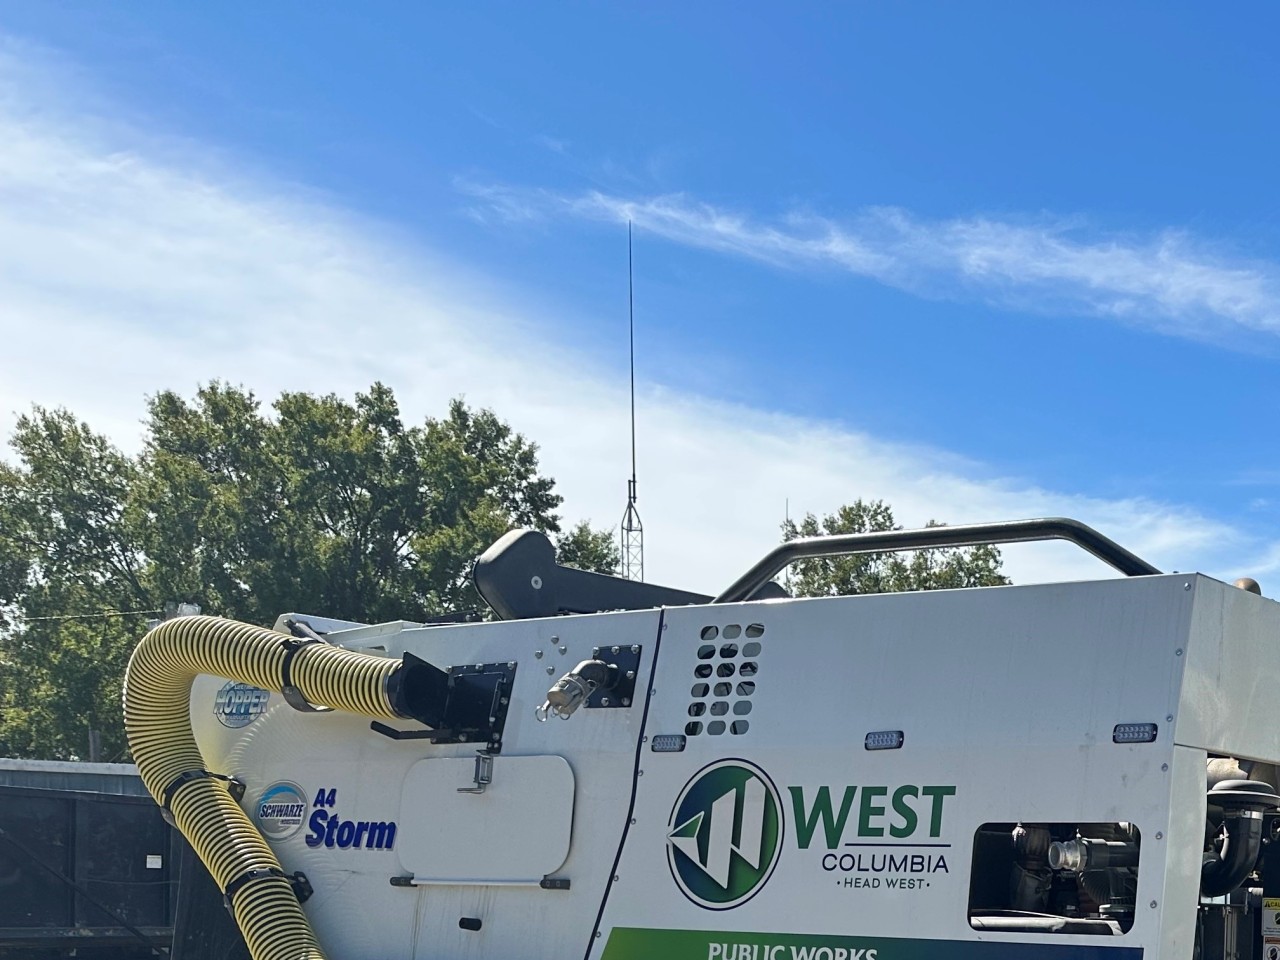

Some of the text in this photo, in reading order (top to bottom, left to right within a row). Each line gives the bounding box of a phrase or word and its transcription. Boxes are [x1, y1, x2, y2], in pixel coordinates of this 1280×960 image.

[213, 689, 270, 714] HOPPER
[313, 788, 337, 808] A4
[260, 804, 305, 818] SCHWARZE
[787, 785, 957, 850] WEST
[305, 809, 397, 849] Storm
[822, 853, 949, 874] COLUMBIA
[843, 877, 925, 890] HEAD WEST
